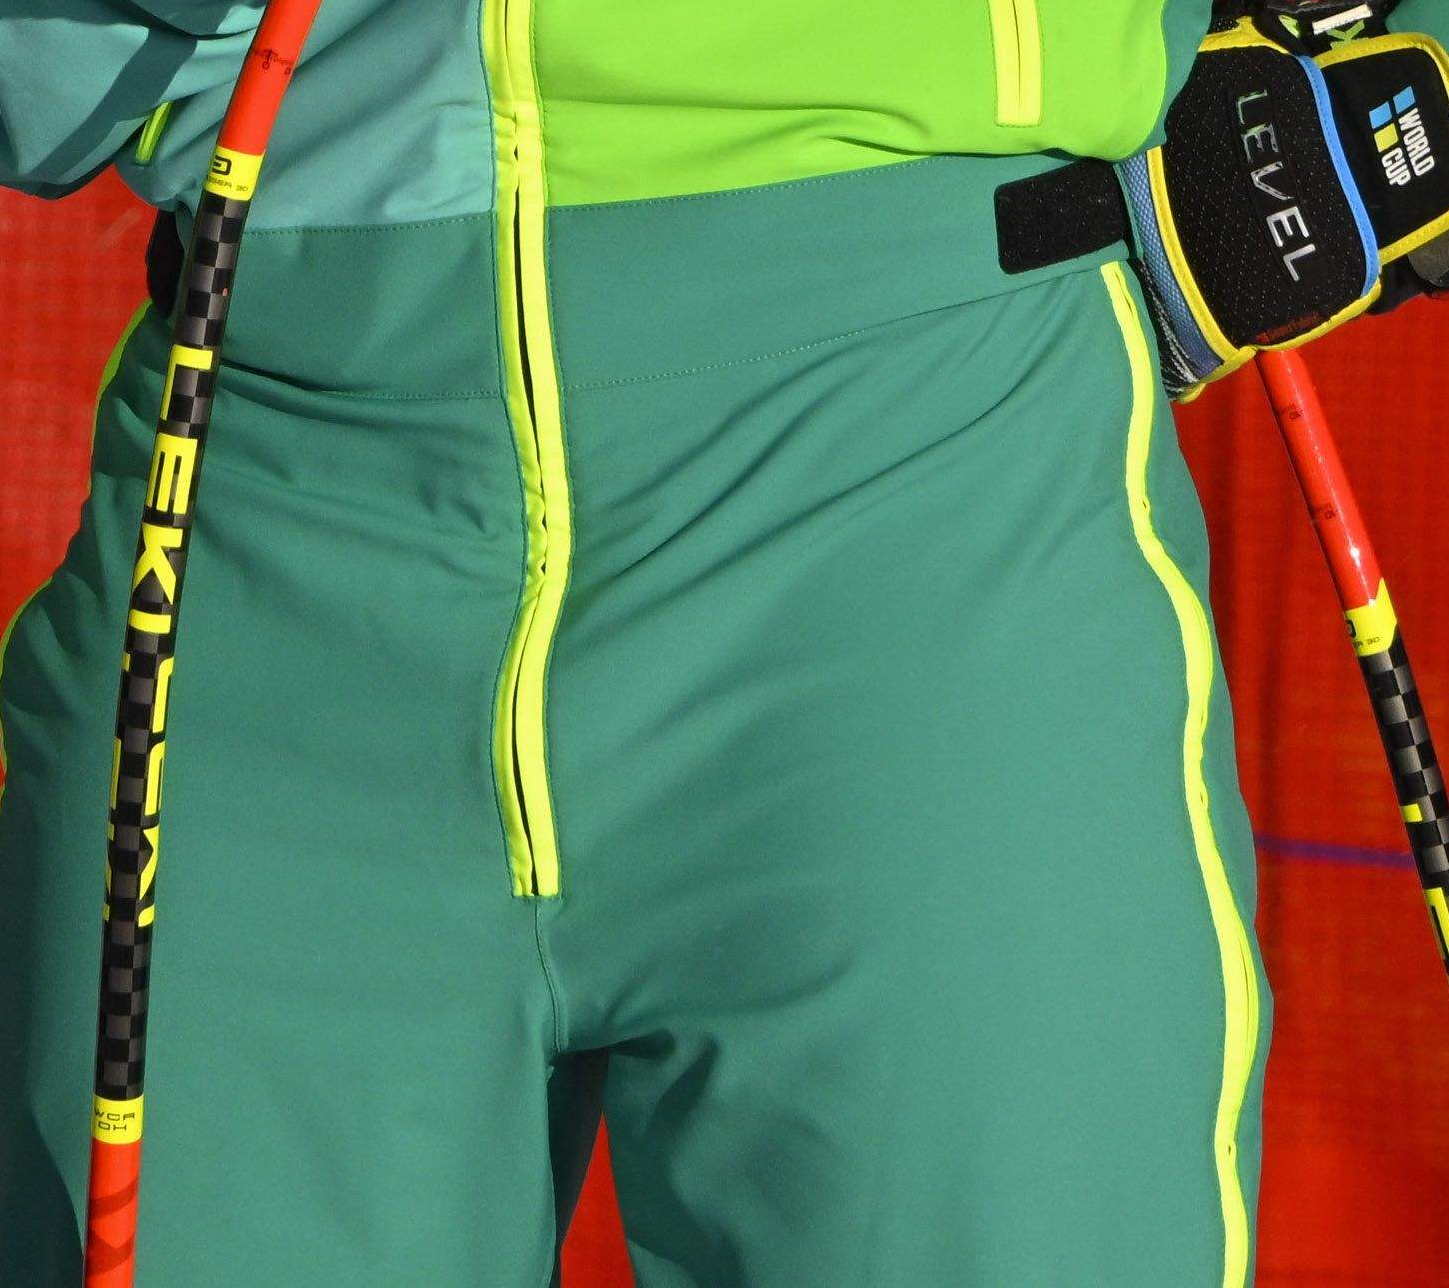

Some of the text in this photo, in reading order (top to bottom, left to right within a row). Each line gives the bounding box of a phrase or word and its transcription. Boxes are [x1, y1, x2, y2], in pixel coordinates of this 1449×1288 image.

[1236, 89, 1316, 282] LEVEL
[1381, 148, 1412, 187] CUP
[1398, 107, 1437, 177] WORLD
[129, 343, 213, 634] LEKI
